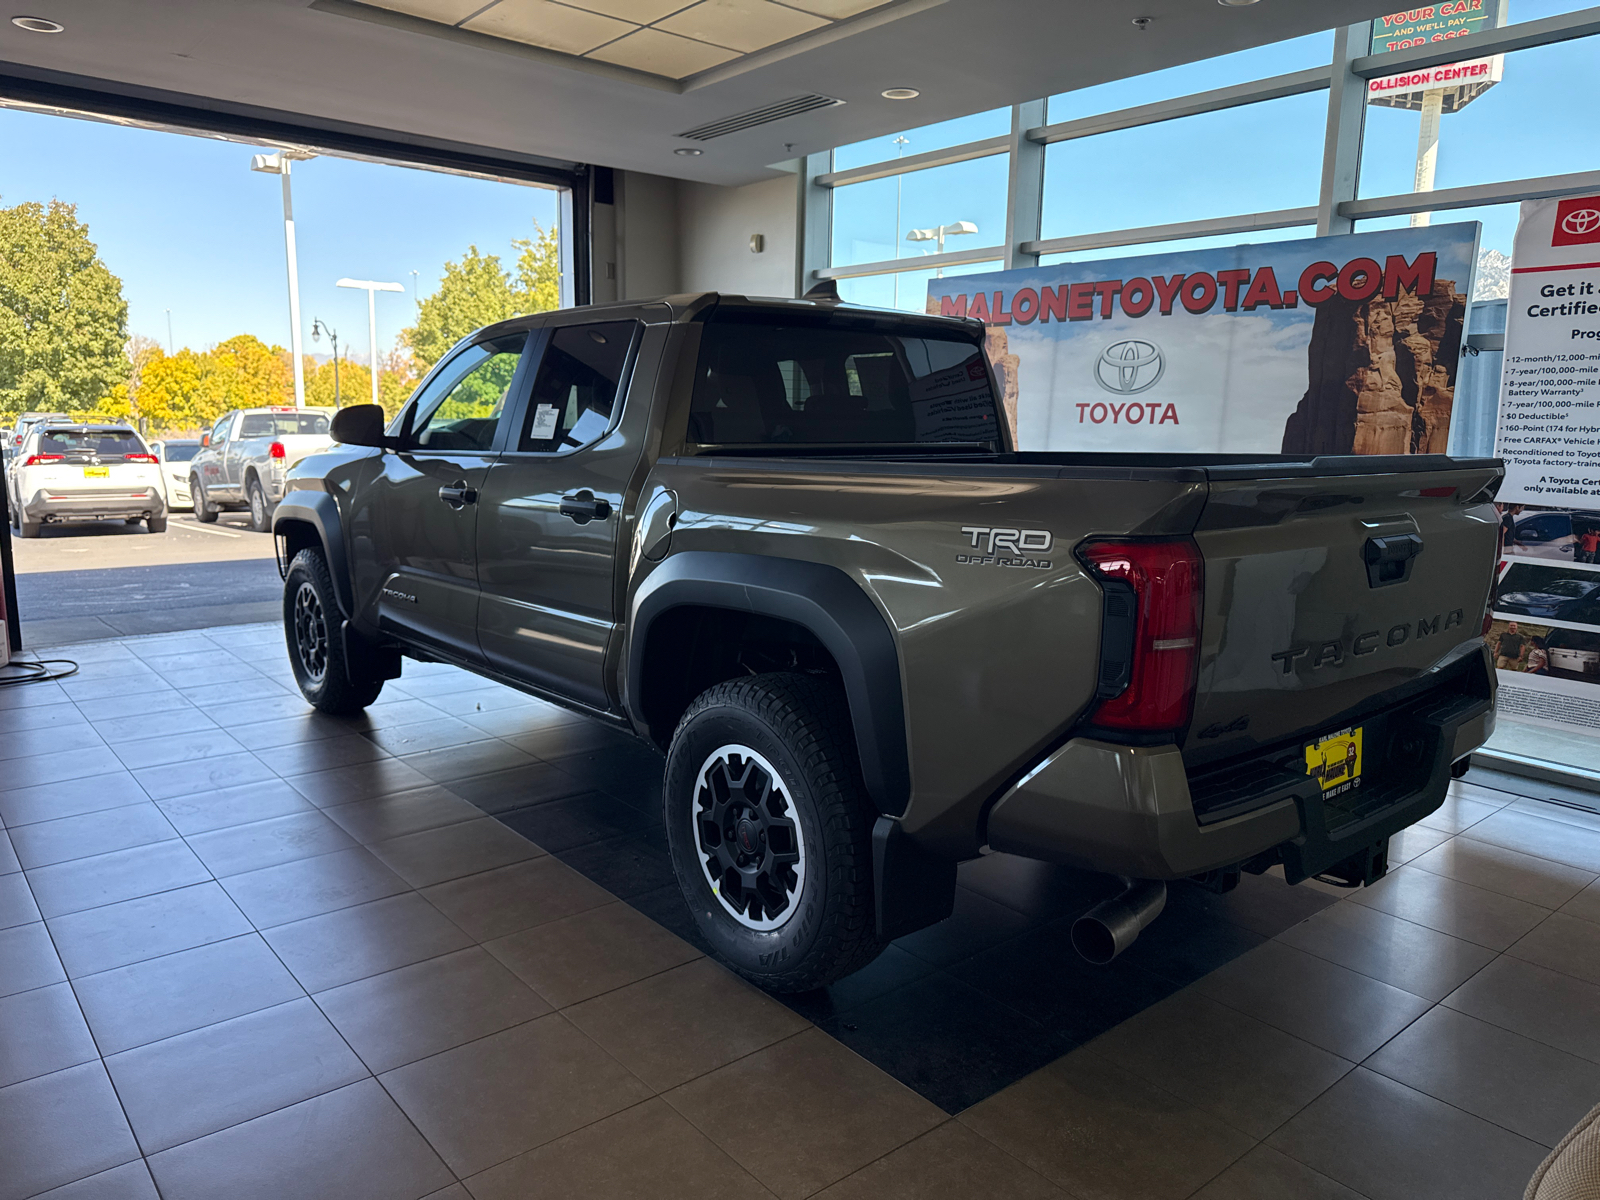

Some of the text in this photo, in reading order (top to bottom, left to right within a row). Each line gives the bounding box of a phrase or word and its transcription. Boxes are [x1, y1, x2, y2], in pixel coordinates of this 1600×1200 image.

[1382, 0, 1482, 28] YOUR CAR
[1394, 17, 1466, 37] AND WE'LL PAY
[1369, 64, 1488, 92] OLLISION CENTER
[940, 251, 1438, 327] MALONETOYOTA.COM
[1540, 284, 1575, 298] Get
[1580, 281, 1594, 296] it
[1527, 301, 1600, 318] Certifie
[1510, 366, 1598, 376] 7-year/100,000-mile
[1509, 378, 1596, 388] 8-year/100,000-mile
[1508, 389, 1539, 397] Battery
[1507, 400, 1595, 409] 7-year/100,000-mile
[1075, 402, 1180, 426] TOYOTA
[1506, 413, 1517, 421] $0
[1546, 425, 1564, 433] (174
[1504, 436, 1522, 444] Free
[1502, 448, 1564, 456] Reconditioned
[1514, 458, 1541, 466] Toyota
[1548, 476, 1580, 485] Toyota
[1524, 485, 1600, 496] only available at
[961, 526, 1053, 556] TRD
[956, 554, 1053, 570] OFF ROAD
[383, 588, 417, 603] TACOMA
[1271, 608, 1464, 676] TACOMA
